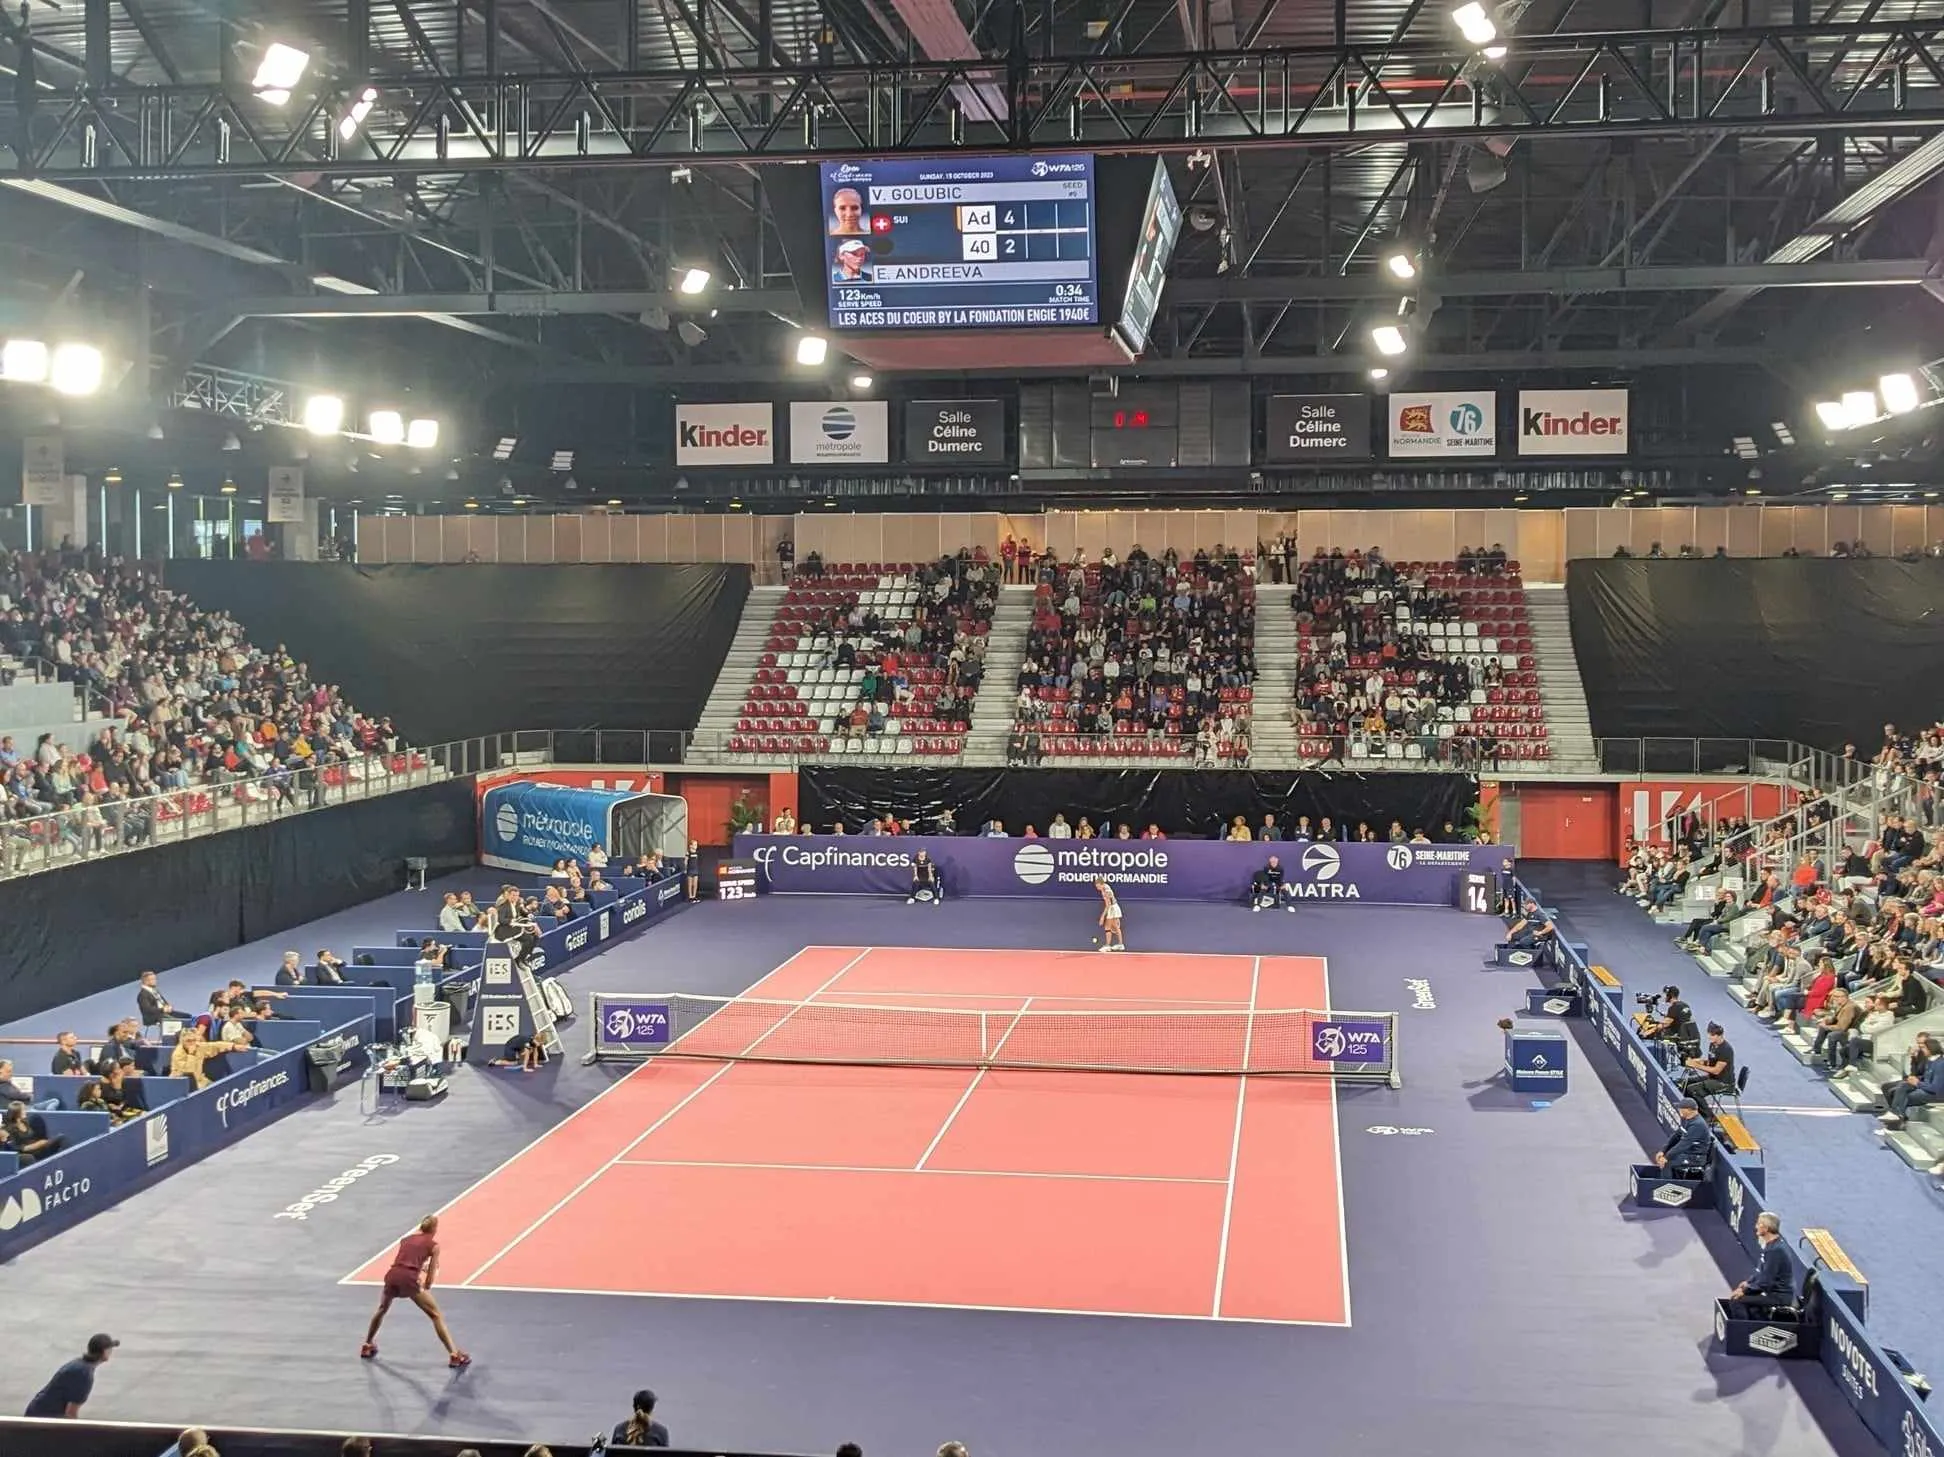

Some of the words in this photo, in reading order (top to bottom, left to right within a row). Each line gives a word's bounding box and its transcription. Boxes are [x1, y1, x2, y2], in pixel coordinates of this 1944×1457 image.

[872, 189, 886, 201] V.
[891, 187, 962, 201] GOLUBIC
[893, 216, 909, 224] SUI
[967, 211, 991, 225] Ad
[1003, 210, 1015, 225] 4
[970, 240, 990, 254] 40
[1005, 239, 1015, 253] 2
[877, 267, 892, 280] E.
[896, 265, 983, 280] ANDREEVA
[1055, 284, 1083, 296] 0:34
[839, 312, 857, 325] LES
[859, 312, 885, 325] ACES
[887, 312, 901, 324] DU
[904, 311, 936, 324] COEUR
[938, 311, 952, 324] BY
[954, 310, 967, 323] LA
[969, 309, 1025, 322] FONDATION
[1027, 308, 1057, 321] ENGIE
[1059, 307, 1091, 321] 1940€
[939, 410, 971, 423] Salle
[1301, 405, 1336, 418] Salle
[933, 425, 977, 438] Céline
[1295, 420, 1341, 432] Céline
[928, 440, 983, 452] Dumerc
[1289, 435, 1347, 447] Dumerc
[1393, 437, 1441, 445] NORMANDIE
[522, 811, 593, 840] métropole
[1058, 846, 1168, 871] métropole
[720, 886, 743, 900] 123
[1284, 883, 1361, 898] MATRA
[1468, 886, 1488, 913] 14
[634, 1013, 667, 1024] WTA
[636, 1025, 654, 1036] 125
[1347, 1032, 1381, 1044] WTA
[1347, 1043, 1368, 1055] 125
[44, 1169, 64, 1191] AD
[45, 1177, 90, 1211] FACTO
[1829, 1316, 1880, 1398] NOVOTEL
